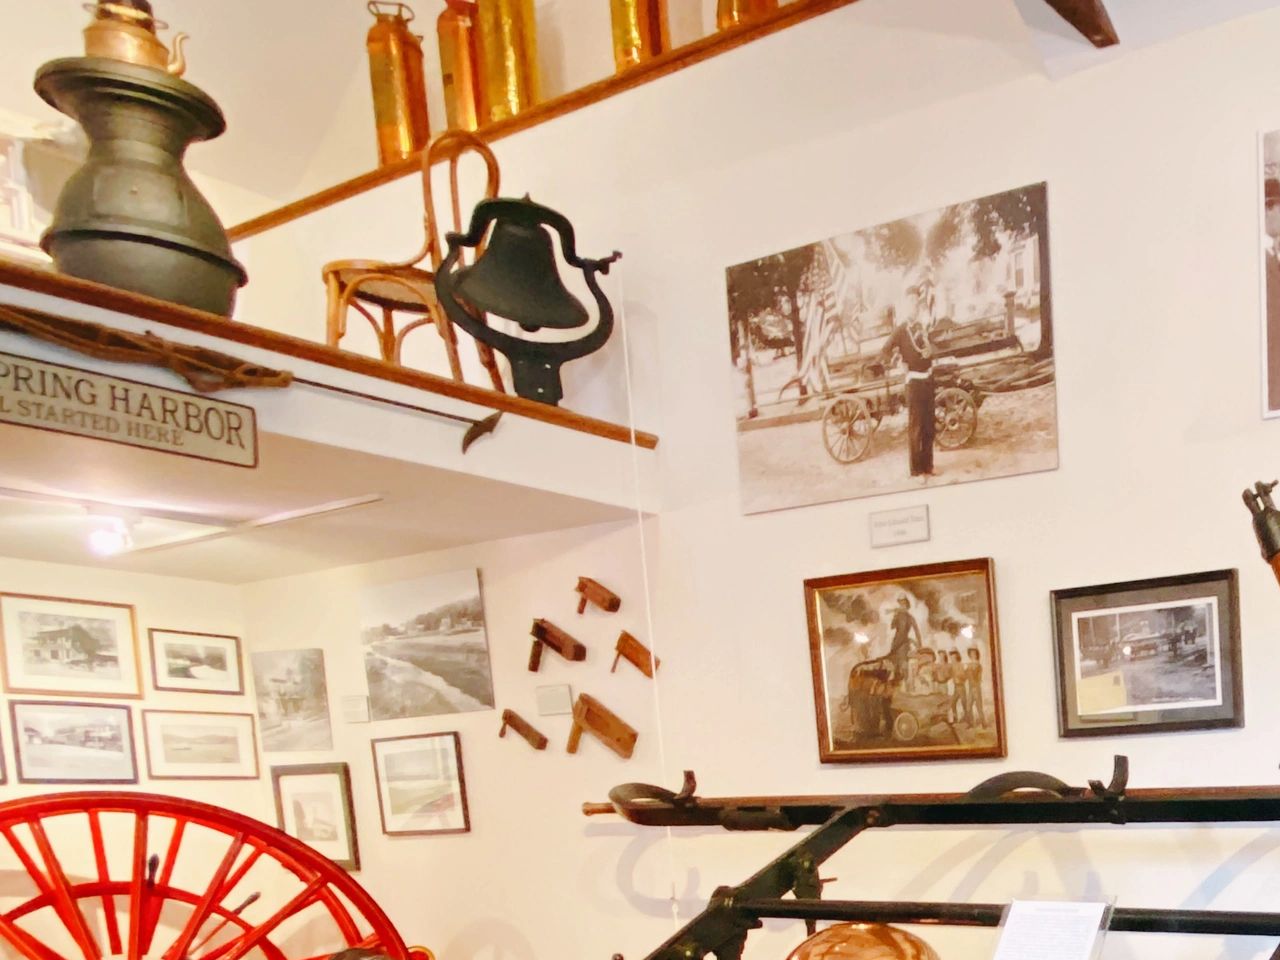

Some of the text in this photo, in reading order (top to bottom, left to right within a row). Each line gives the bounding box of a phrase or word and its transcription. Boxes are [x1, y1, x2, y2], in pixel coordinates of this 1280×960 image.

[16, 399, 121, 435] STARTED
[126, 421, 185, 447] HERE
[108, 384, 246, 450] HARBOR
